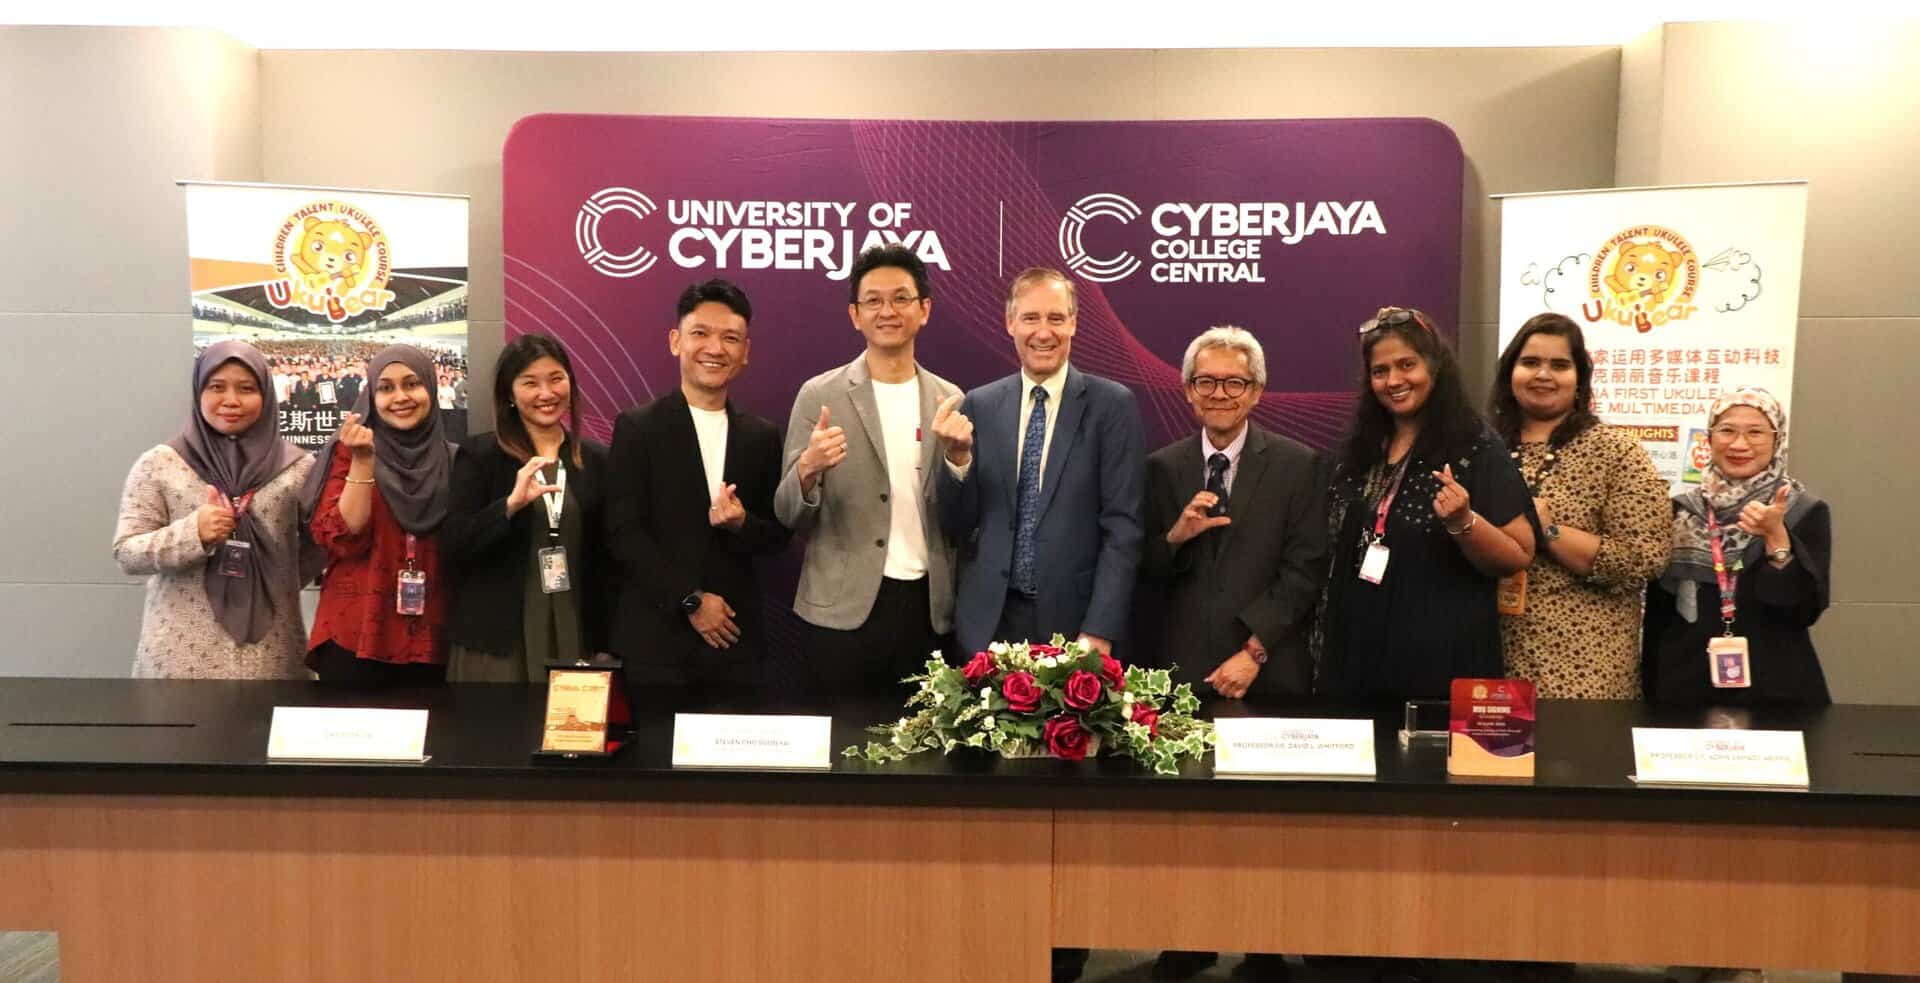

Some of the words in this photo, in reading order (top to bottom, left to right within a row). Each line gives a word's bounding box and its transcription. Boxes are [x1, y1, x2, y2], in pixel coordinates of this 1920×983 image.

[667, 200, 856, 227] UNIVERSITY
[868, 202, 912, 228] OF
[1151, 200, 1386, 244] CYBERJAYA
[275, 222, 294, 273] CHILDREN
[294, 203, 334, 220] TALENT
[340, 205, 380, 237] UKULELE
[376, 241, 388, 282] COURSE
[1150, 239, 1261, 259] COLLEGE
[1150, 262, 1265, 283] CENTRAL
[1591, 247, 1610, 293] CHILDREN
[1610, 228, 1648, 246] TALENT
[1654, 229, 1691, 256] UKULELE
[1683, 259, 1697, 297] COURSE
[1588, 348, 1780, 365] 家运用多媒体互动科技
[1614, 387, 1658, 400] FIRST
[1608, 402, 1706, 415] MULTIMEDIA
